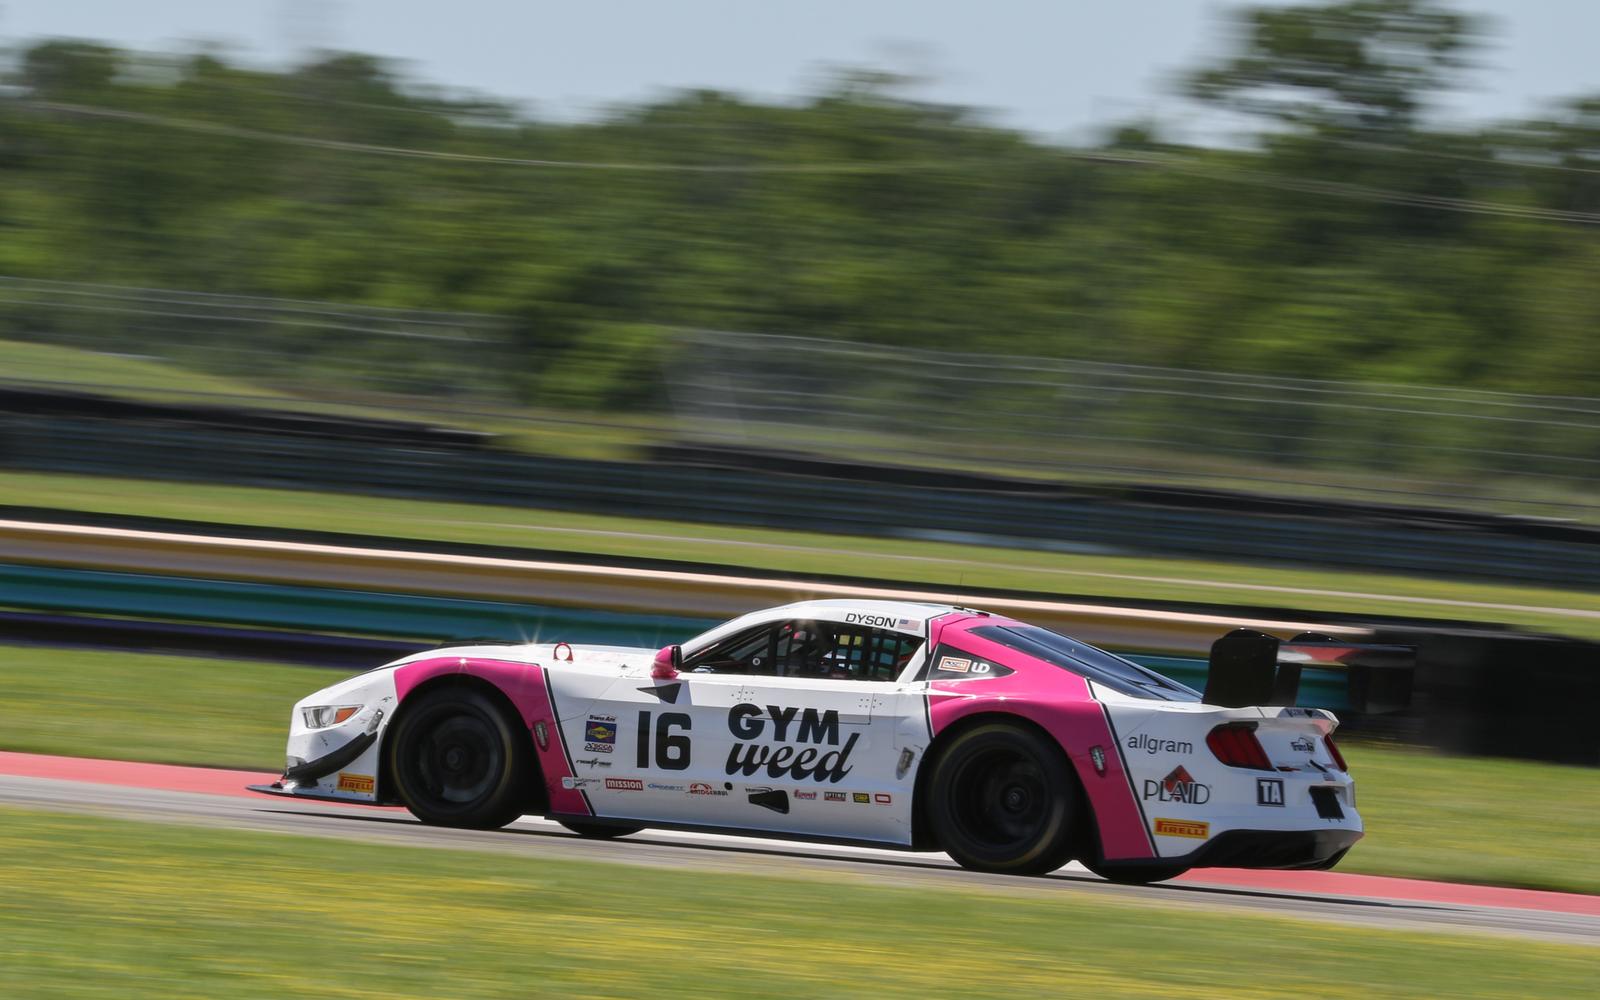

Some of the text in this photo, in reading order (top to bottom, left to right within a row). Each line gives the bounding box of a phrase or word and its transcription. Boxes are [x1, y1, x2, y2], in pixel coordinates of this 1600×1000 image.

[845, 613, 897, 628] DYSON
[728, 703, 839, 746] GYM
[637, 711, 692, 770] 16
[1127, 734, 1193, 754] allgram
[725, 732, 861, 784] weed
[1143, 779, 1211, 805] PLAID
[1260, 781, 1282, 803] TA
[1156, 820, 1208, 835] PIRELLI
